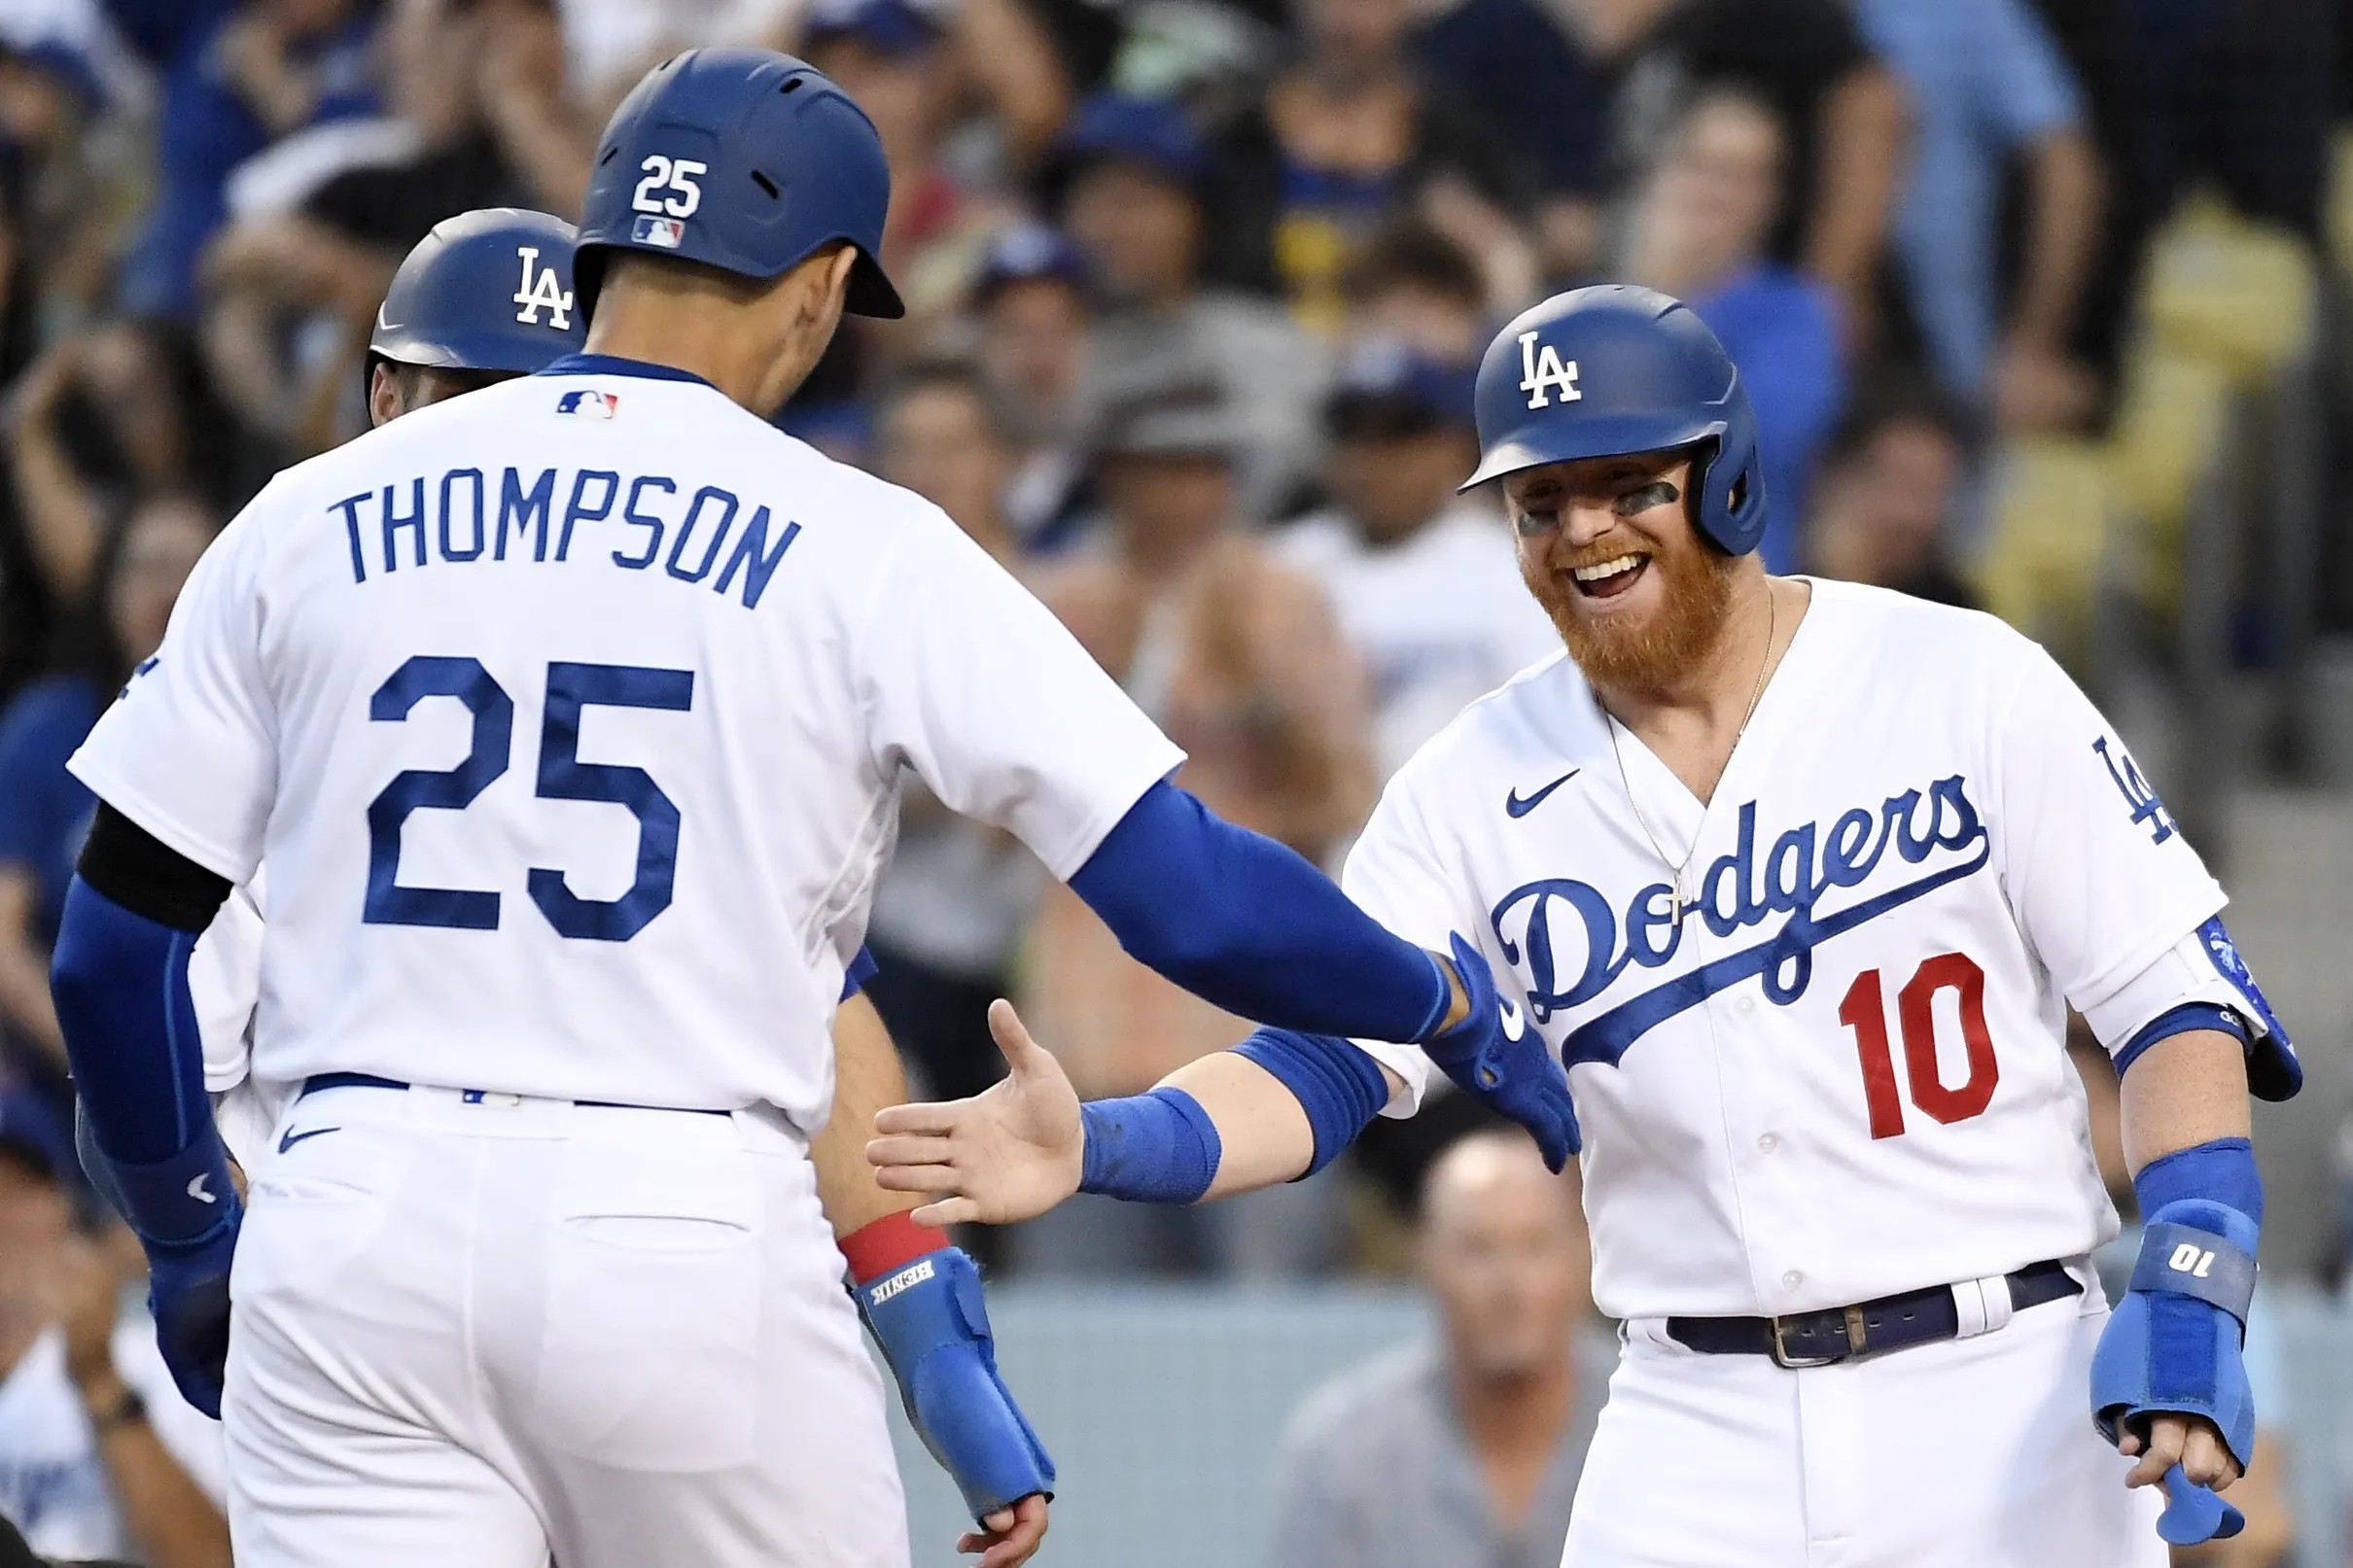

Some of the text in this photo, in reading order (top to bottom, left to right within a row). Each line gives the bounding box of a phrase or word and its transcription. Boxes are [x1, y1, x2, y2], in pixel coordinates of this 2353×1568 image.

[633, 156, 707, 218] 25
[513, 247, 574, 331] LA
[1518, 331, 1582, 409] LA
[329, 468, 801, 610] THOMPSON
[363, 656, 694, 942] 25
[1491, 775, 1990, 1026] Dodgers
[1839, 953, 1999, 1139] 10
[2168, 1243, 2215, 1277] 10
